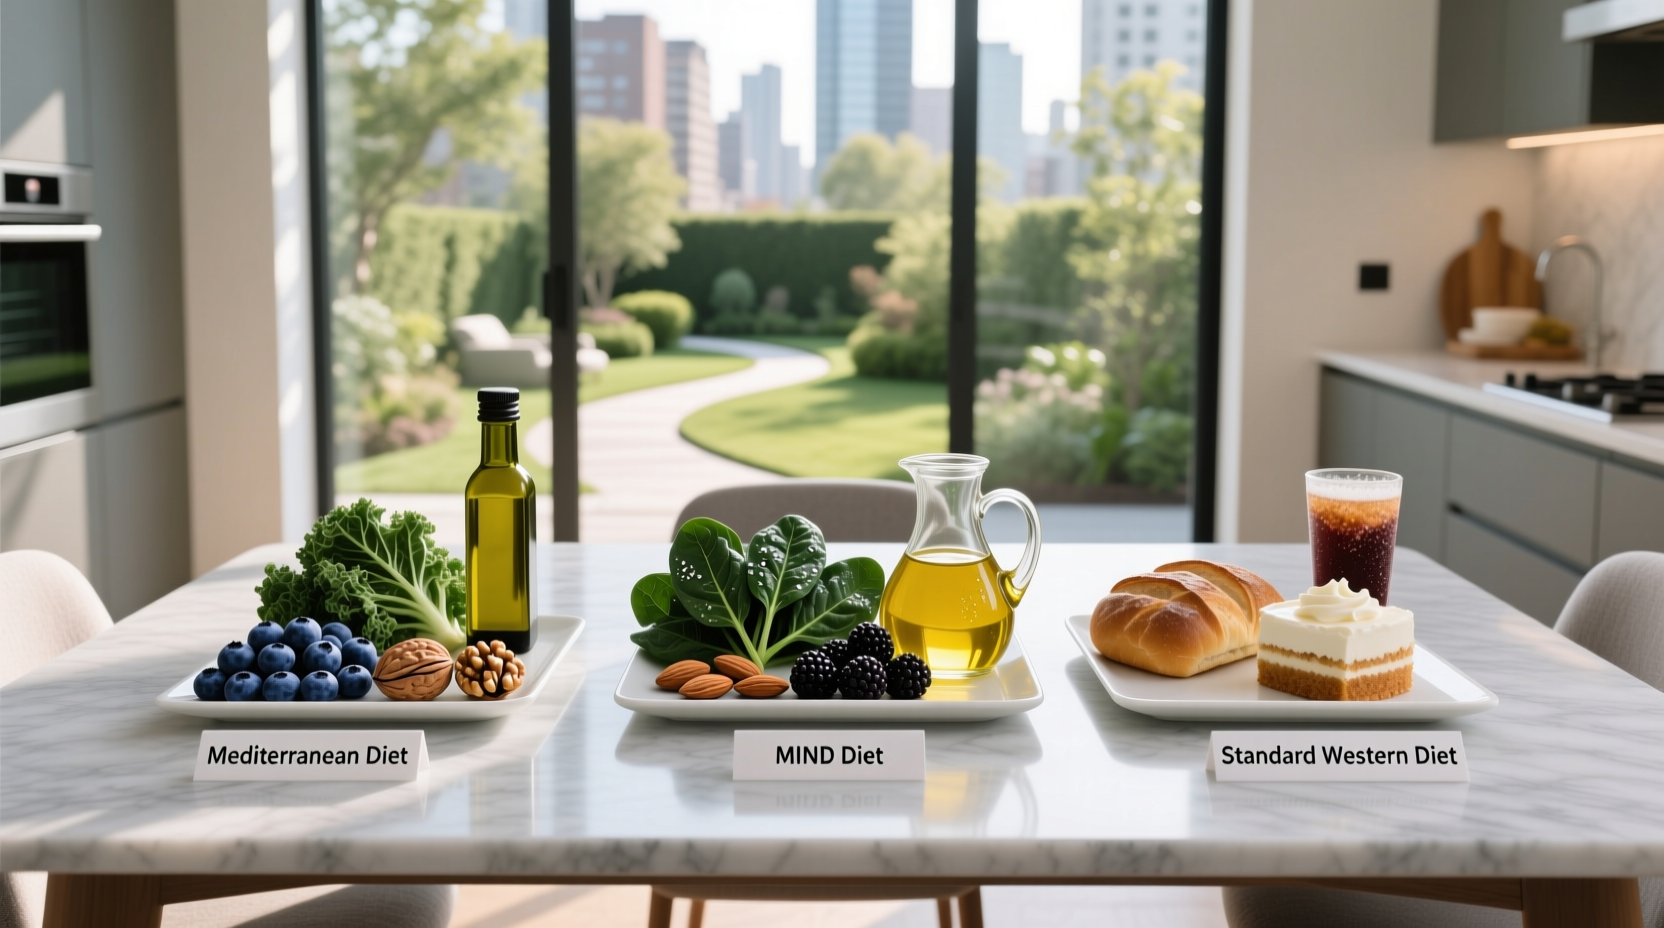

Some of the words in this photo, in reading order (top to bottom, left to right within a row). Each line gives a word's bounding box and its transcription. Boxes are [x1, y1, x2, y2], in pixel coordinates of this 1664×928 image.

[207, 744, 359, 765] Mediterranean
[366, 745, 409, 765] Diet
[776, 745, 835, 765] MIND
[841, 745, 884, 765] Diet
[1221, 744, 1316, 765] Standard
[1321, 745, 1408, 765] Western
[1414, 745, 1458, 765] Diet
